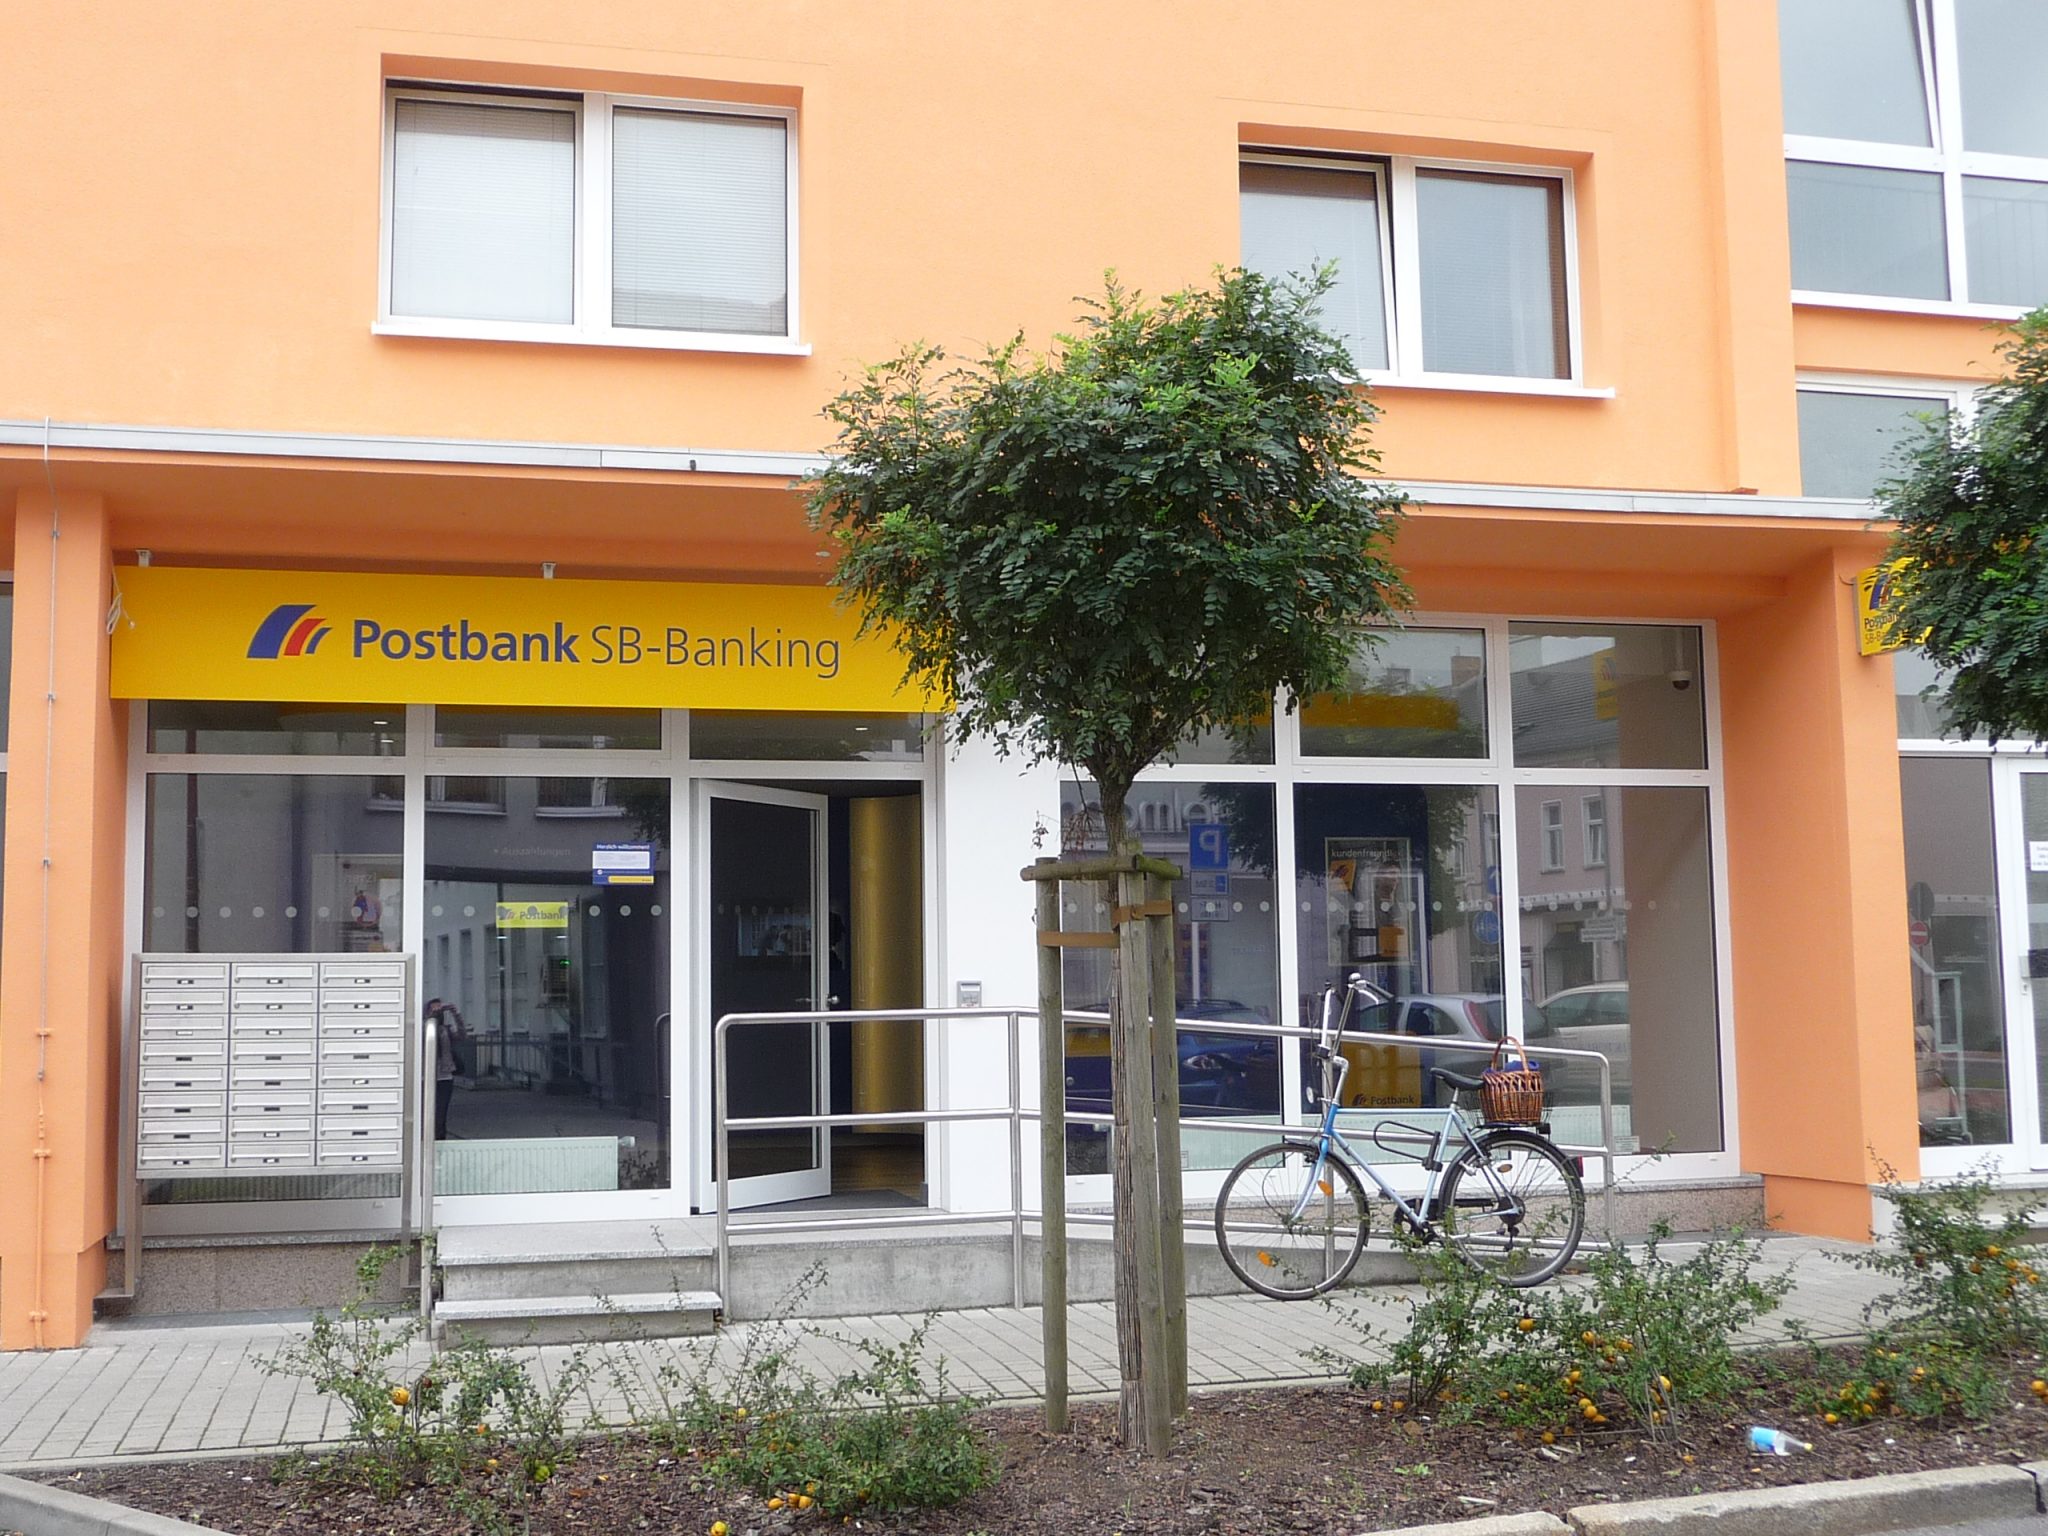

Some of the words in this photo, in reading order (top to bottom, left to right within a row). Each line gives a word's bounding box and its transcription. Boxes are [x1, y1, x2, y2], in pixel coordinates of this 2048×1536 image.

[353, 618, 581, 664] Postbank
[591, 625, 840, 679] SB-Banking
[1371, 1095, 1415, 1105] Postbank
